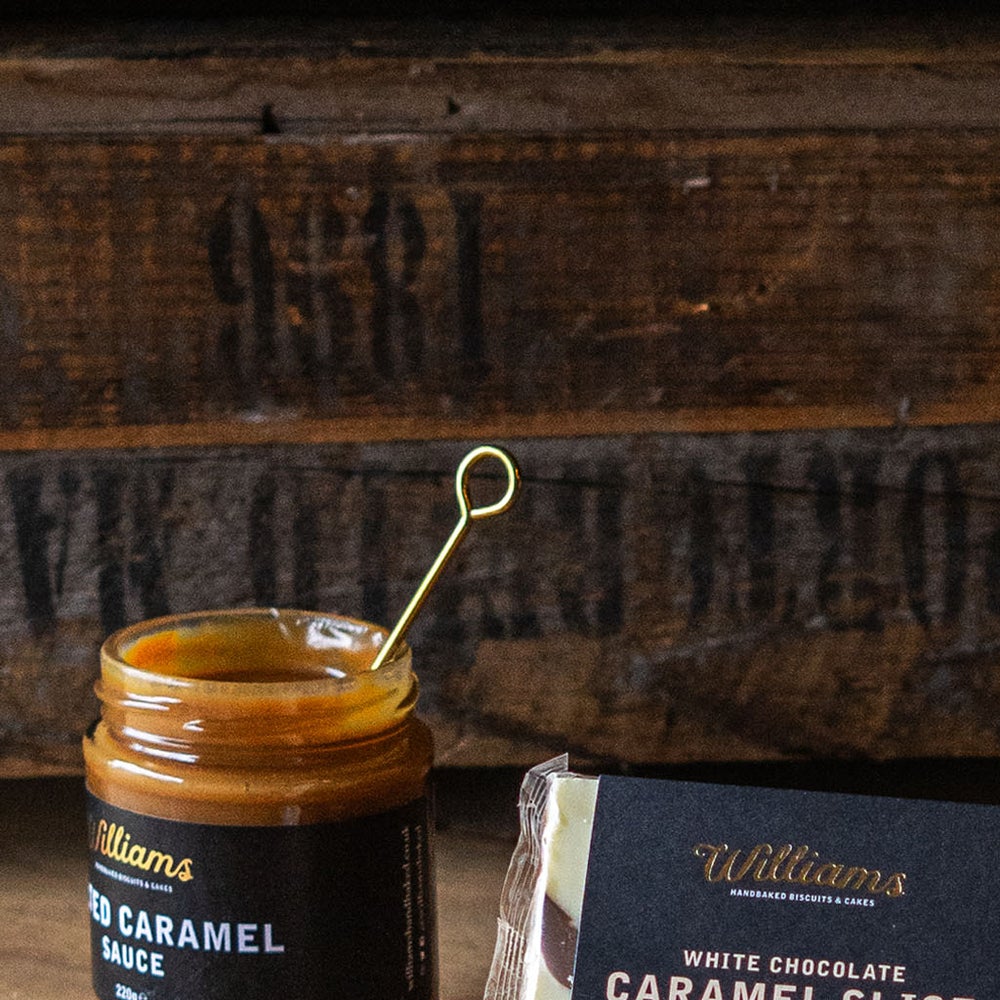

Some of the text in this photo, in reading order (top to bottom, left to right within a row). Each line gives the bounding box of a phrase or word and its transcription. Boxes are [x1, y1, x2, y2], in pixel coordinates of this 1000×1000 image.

[692, 843, 906, 897] Williams
[730, 888, 875, 907] HANDBAKED BISCUITS & CAKES
[118, 904, 286, 953] CARAMEL
[101, 934, 165, 977] SAUCE
[684, 950, 906, 983] WHITE CHOCOLATE
